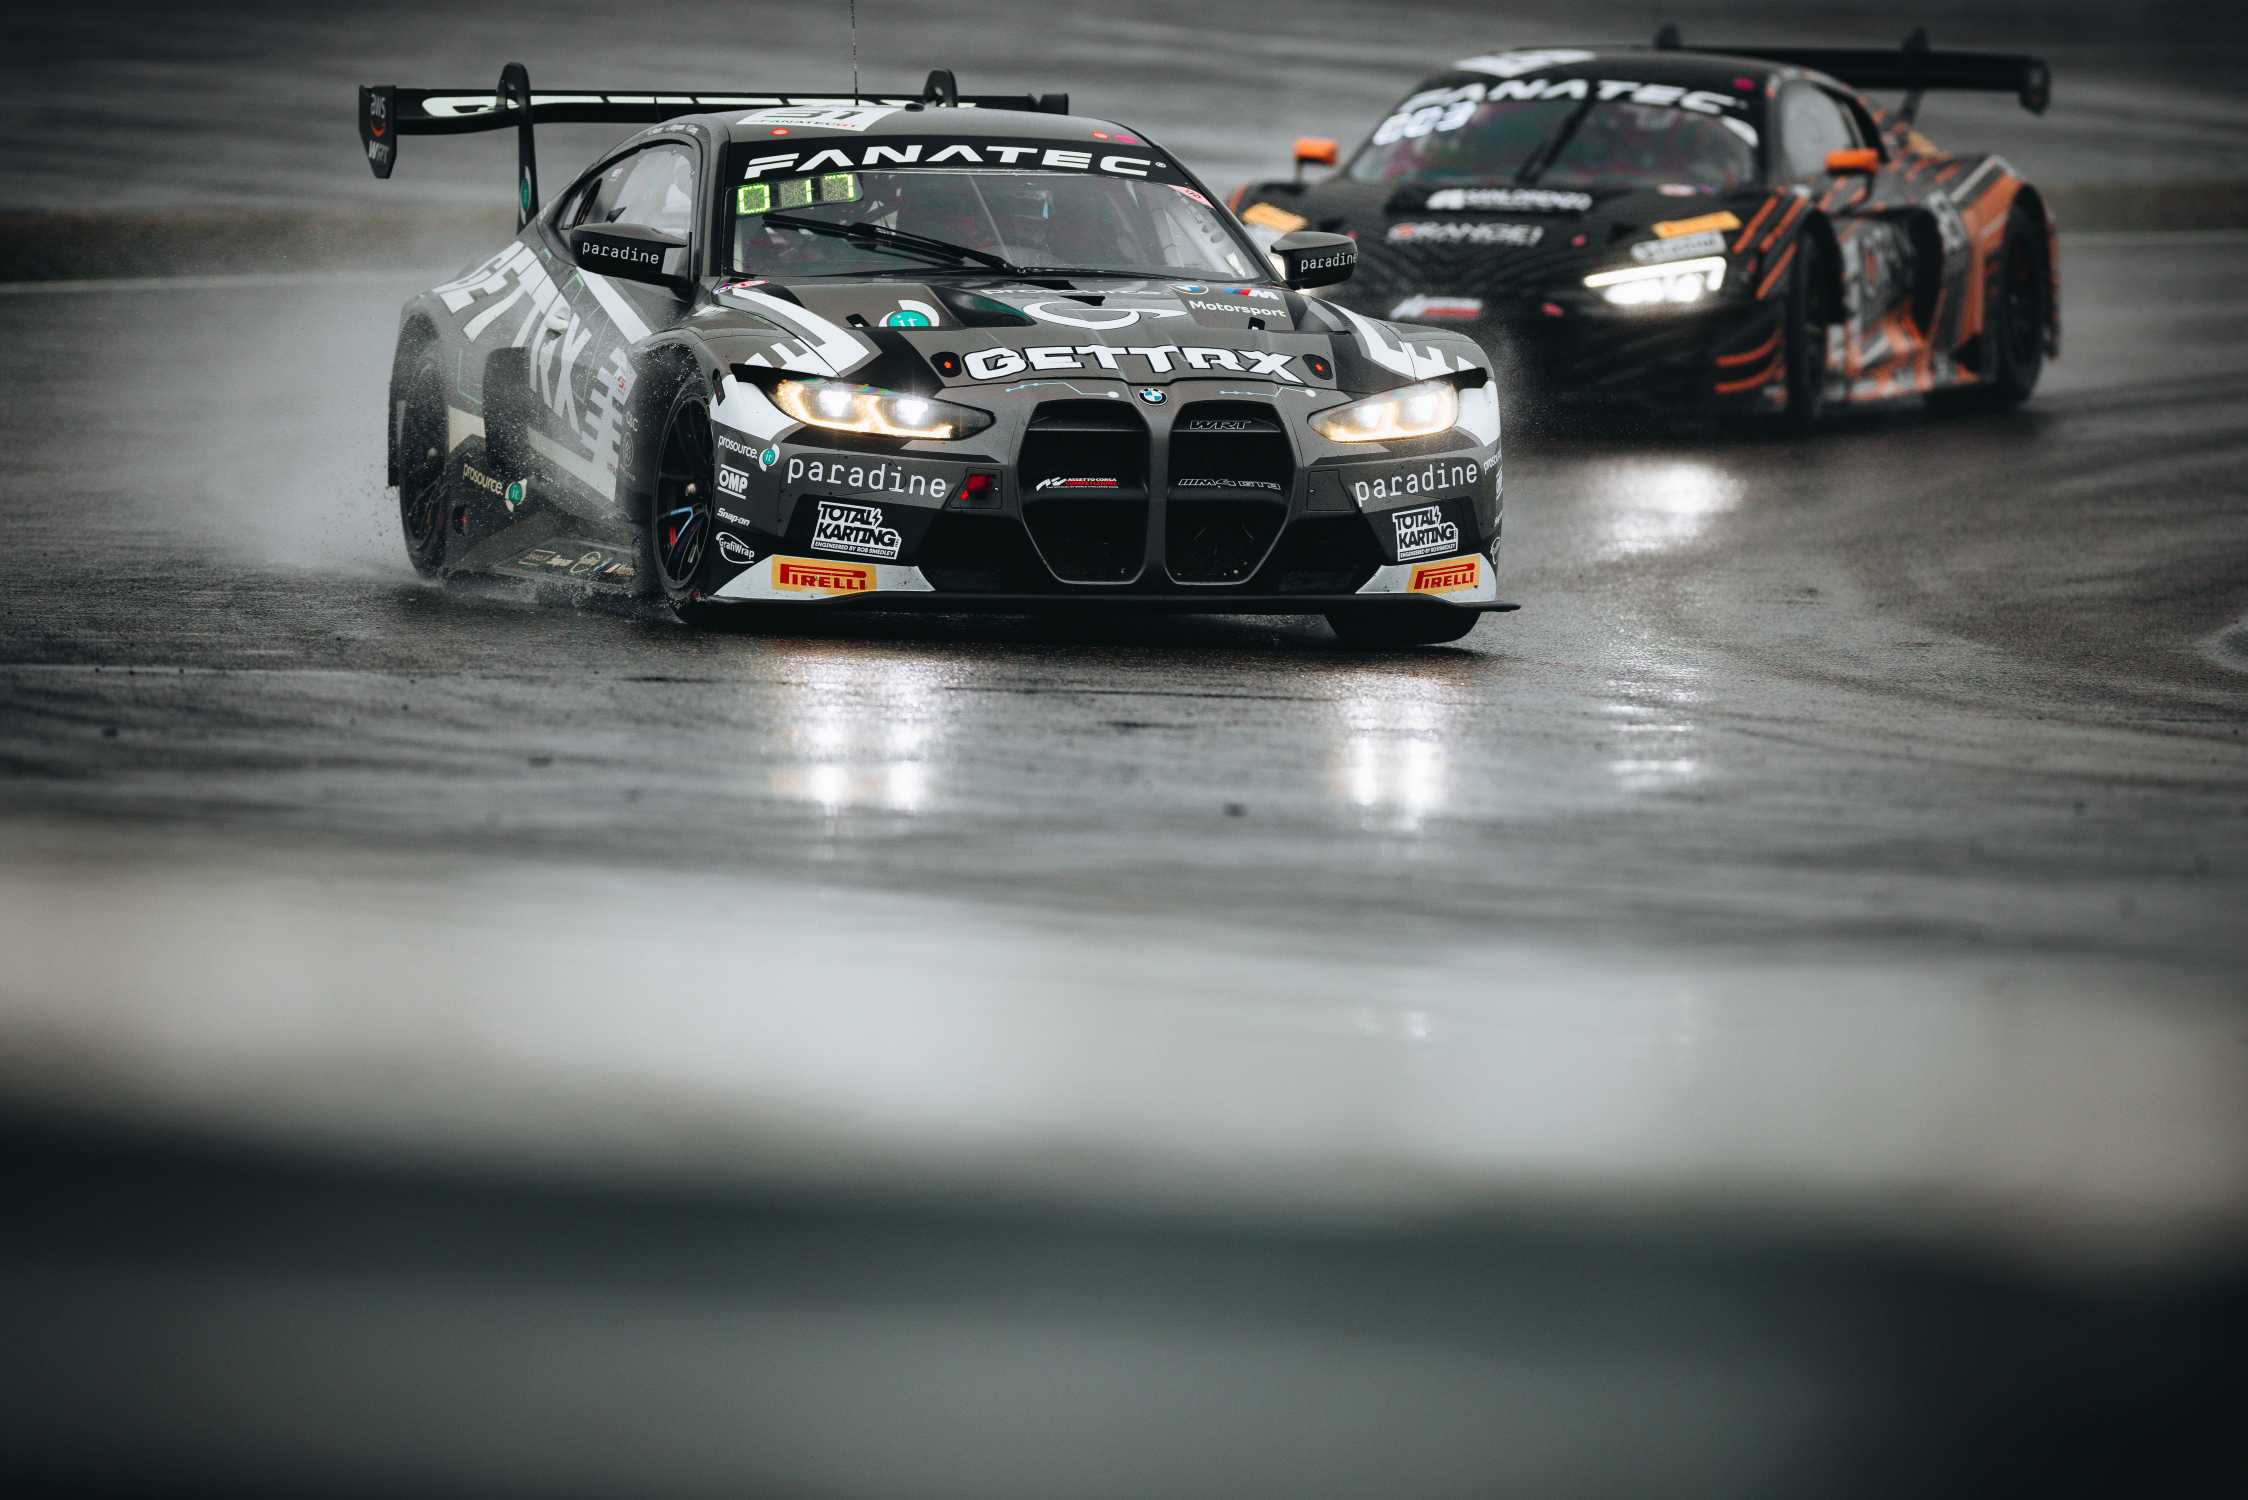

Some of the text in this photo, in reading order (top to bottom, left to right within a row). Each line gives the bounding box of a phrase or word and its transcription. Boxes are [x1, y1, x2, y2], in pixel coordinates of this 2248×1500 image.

[1399, 78, 1735, 115] FANATEC
[743, 144, 1152, 180] FANATEC
[582, 240, 660, 265] paradine
[1301, 252, 1358, 272] paradine
[1188, 300, 1287, 318] Motorsport
[963, 344, 1304, 384] GETTRX
[1189, 420, 1252, 430] WRT
[718, 435, 758, 460] prosource.
[719, 469, 748, 493] OMP
[788, 457, 947, 498] paradine
[1356, 462, 1477, 506] paradine
[717, 507, 750, 526] Snap-on
[820, 503, 876, 527] TOTAL
[1394, 508, 1436, 531] TOTAL
[815, 541, 849, 551] ENGINEERED
[816, 522, 897, 548] KARTING
[1398, 523, 1456, 549] KARTING
[719, 538, 755, 559] GrafiWrap
[779, 563, 870, 591] PIRELLI
[1413, 563, 1475, 590] PIRELLI
